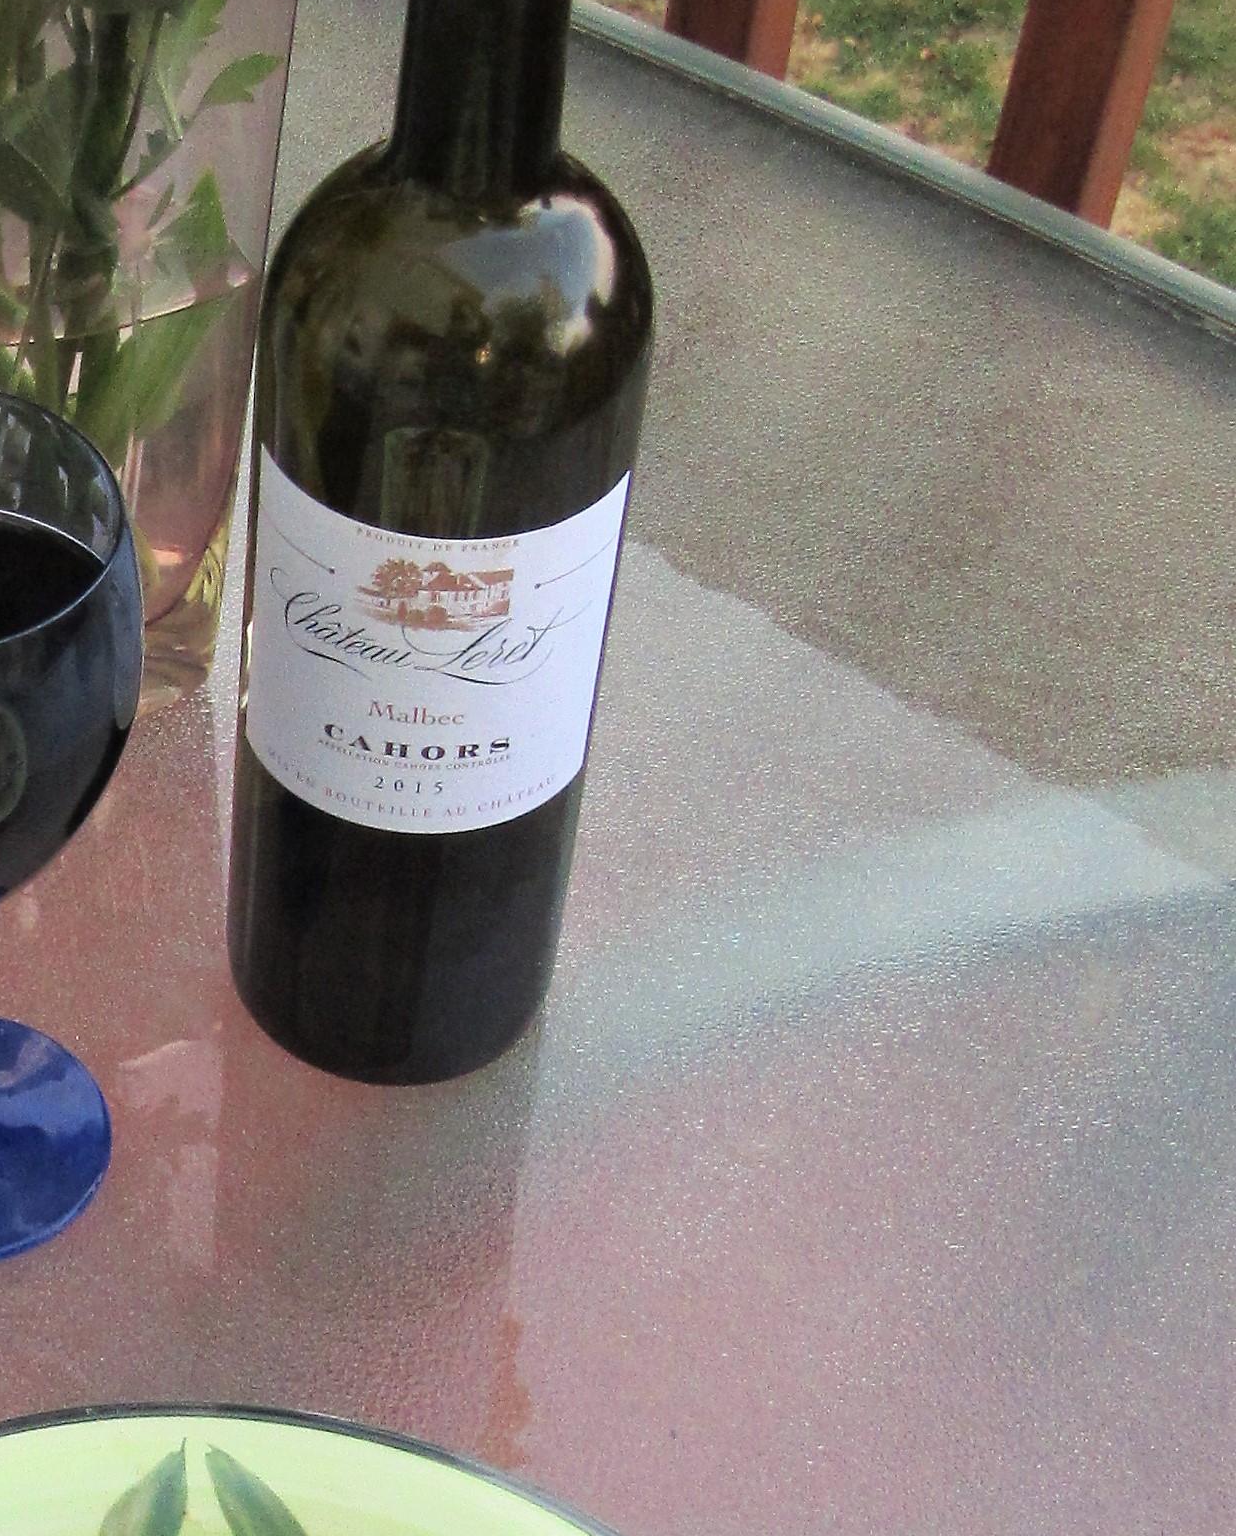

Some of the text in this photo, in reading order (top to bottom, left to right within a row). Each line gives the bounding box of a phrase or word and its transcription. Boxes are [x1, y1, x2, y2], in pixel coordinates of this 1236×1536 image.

[461, 538, 520, 552] FRANCE
[369, 699, 465, 726] Malbec
[323, 723, 511, 761] CAHORS
[373, 775, 444, 795] 2015
